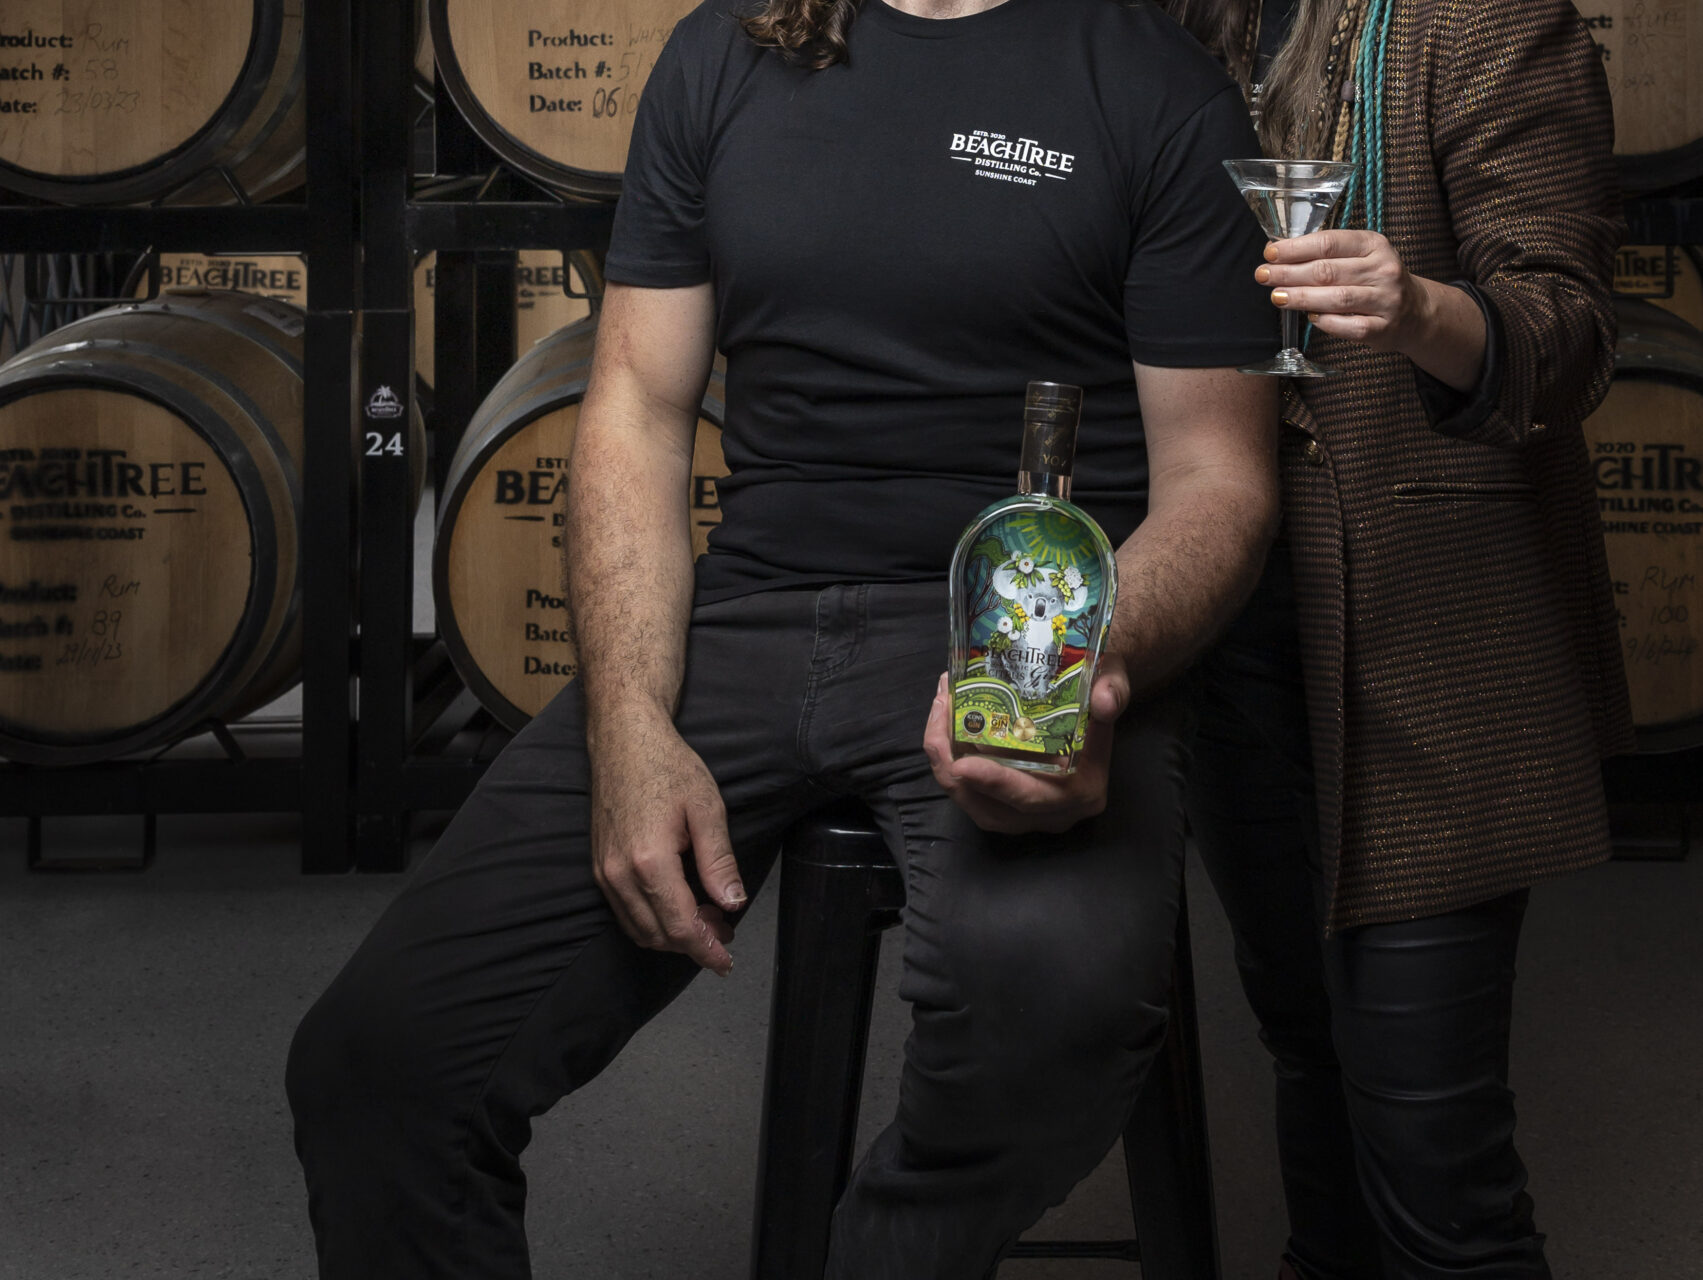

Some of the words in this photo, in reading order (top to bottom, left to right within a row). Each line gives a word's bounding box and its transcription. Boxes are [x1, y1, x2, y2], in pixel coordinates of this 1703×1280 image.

[0, 30, 73, 48] roduct:
[528, 29, 613, 48] Product:
[0, 63, 43, 81] atch
[52, 63, 70, 81] #:
[528, 61, 587, 80] Batch
[595, 60, 612, 78] #:
[0, 98, 37, 113] ate:
[530, 94, 583, 113] Date:
[990, 132, 1006, 140] 2020
[950, 133, 1075, 173] BEACHTREE
[975, 158, 1028, 173] DISTILLING
[1029, 168, 1042, 177] Co.
[975, 169, 1013, 182] SUNSHINE
[1013, 176, 1037, 186] COAST
[160, 262, 300, 290] BEACHTREE
[365, 432, 404, 456] 24
[1595, 442, 1635, 453] 2020
[0, 450, 207, 498] ACHTREE
[122, 505, 146, 519] Co.
[1599, 498, 1674, 512] TILLING
[97, 527, 145, 540] COAST
[1652, 522, 1702, 534] COAST
[0, 581, 77, 602] roduct:
[525, 623, 569, 642] Batc
[0, 654, 41, 670] ate:
[524, 656, 577, 676] Date:
